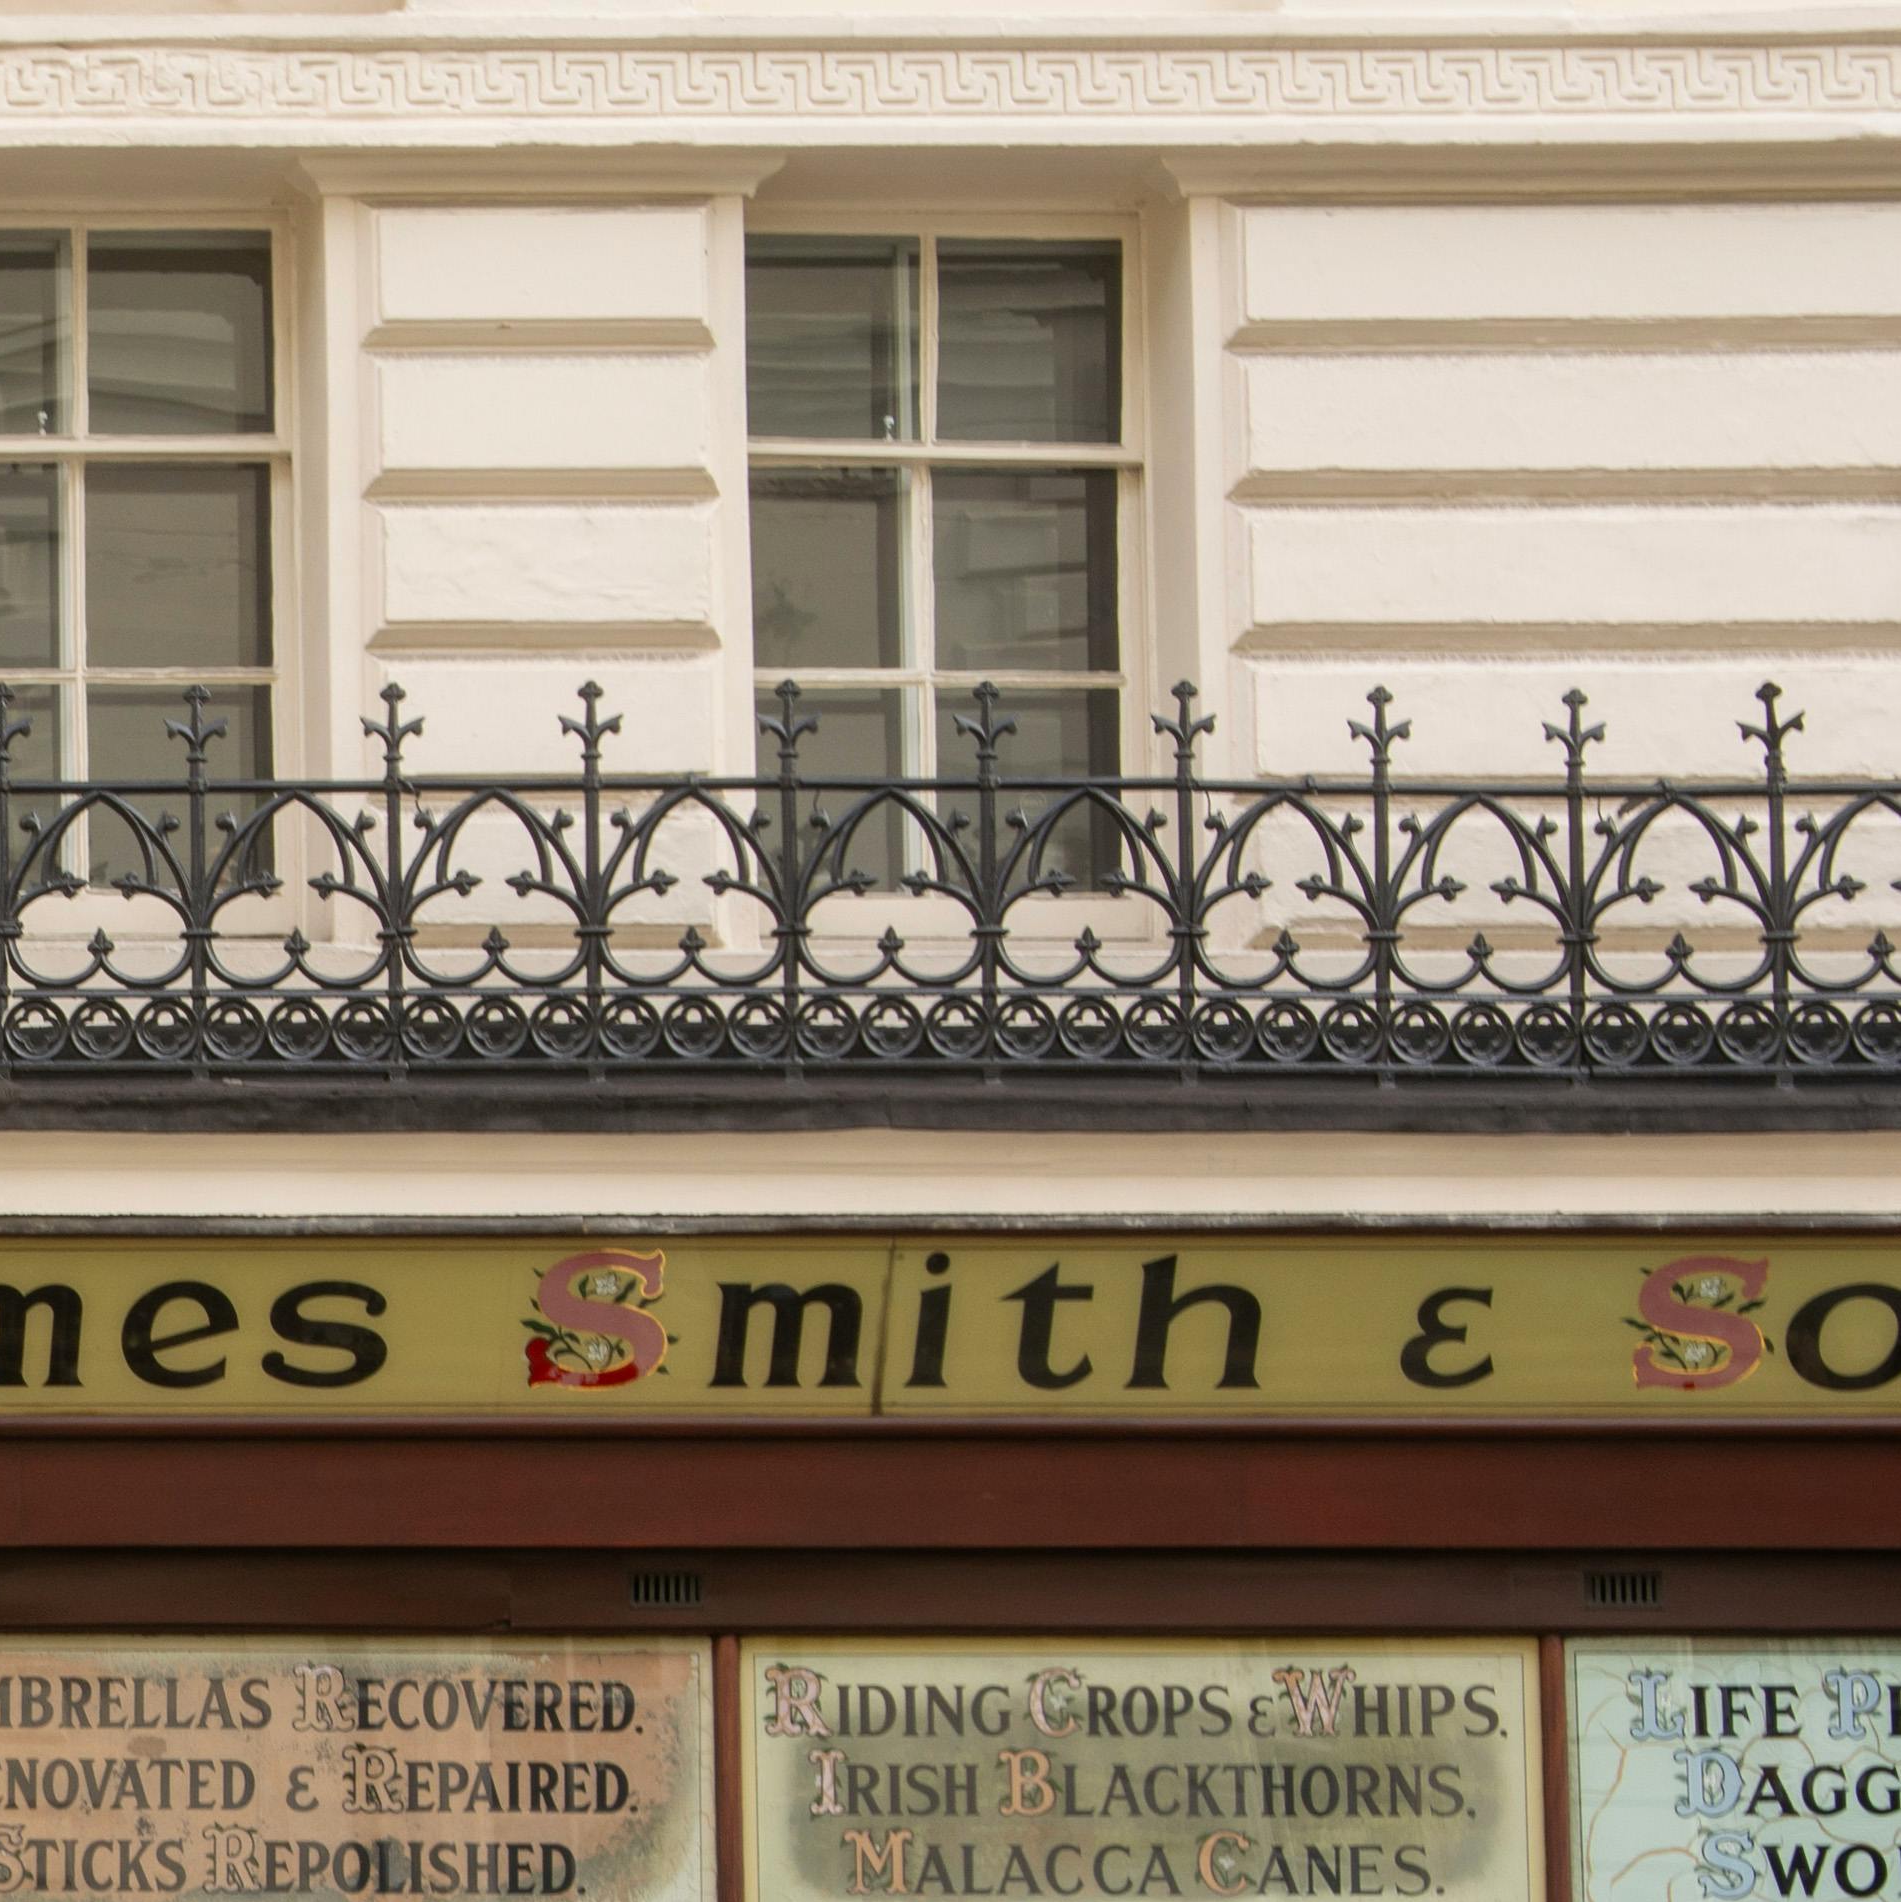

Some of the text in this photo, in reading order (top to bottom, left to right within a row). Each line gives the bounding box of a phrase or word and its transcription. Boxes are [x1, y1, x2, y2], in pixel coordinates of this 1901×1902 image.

[524, 1247, 1263, 1392] Smith
[764, 1663, 1011, 1740] RIDING
[1024, 1666, 1230, 1738] CROPS
[1628, 1668, 1802, 1741] LIFE
[808, 1748, 978, 1818] IRISH
[844, 1828, 1182, 1897] MALACCA
[1698, 1830, 1901, 1899] SWO
